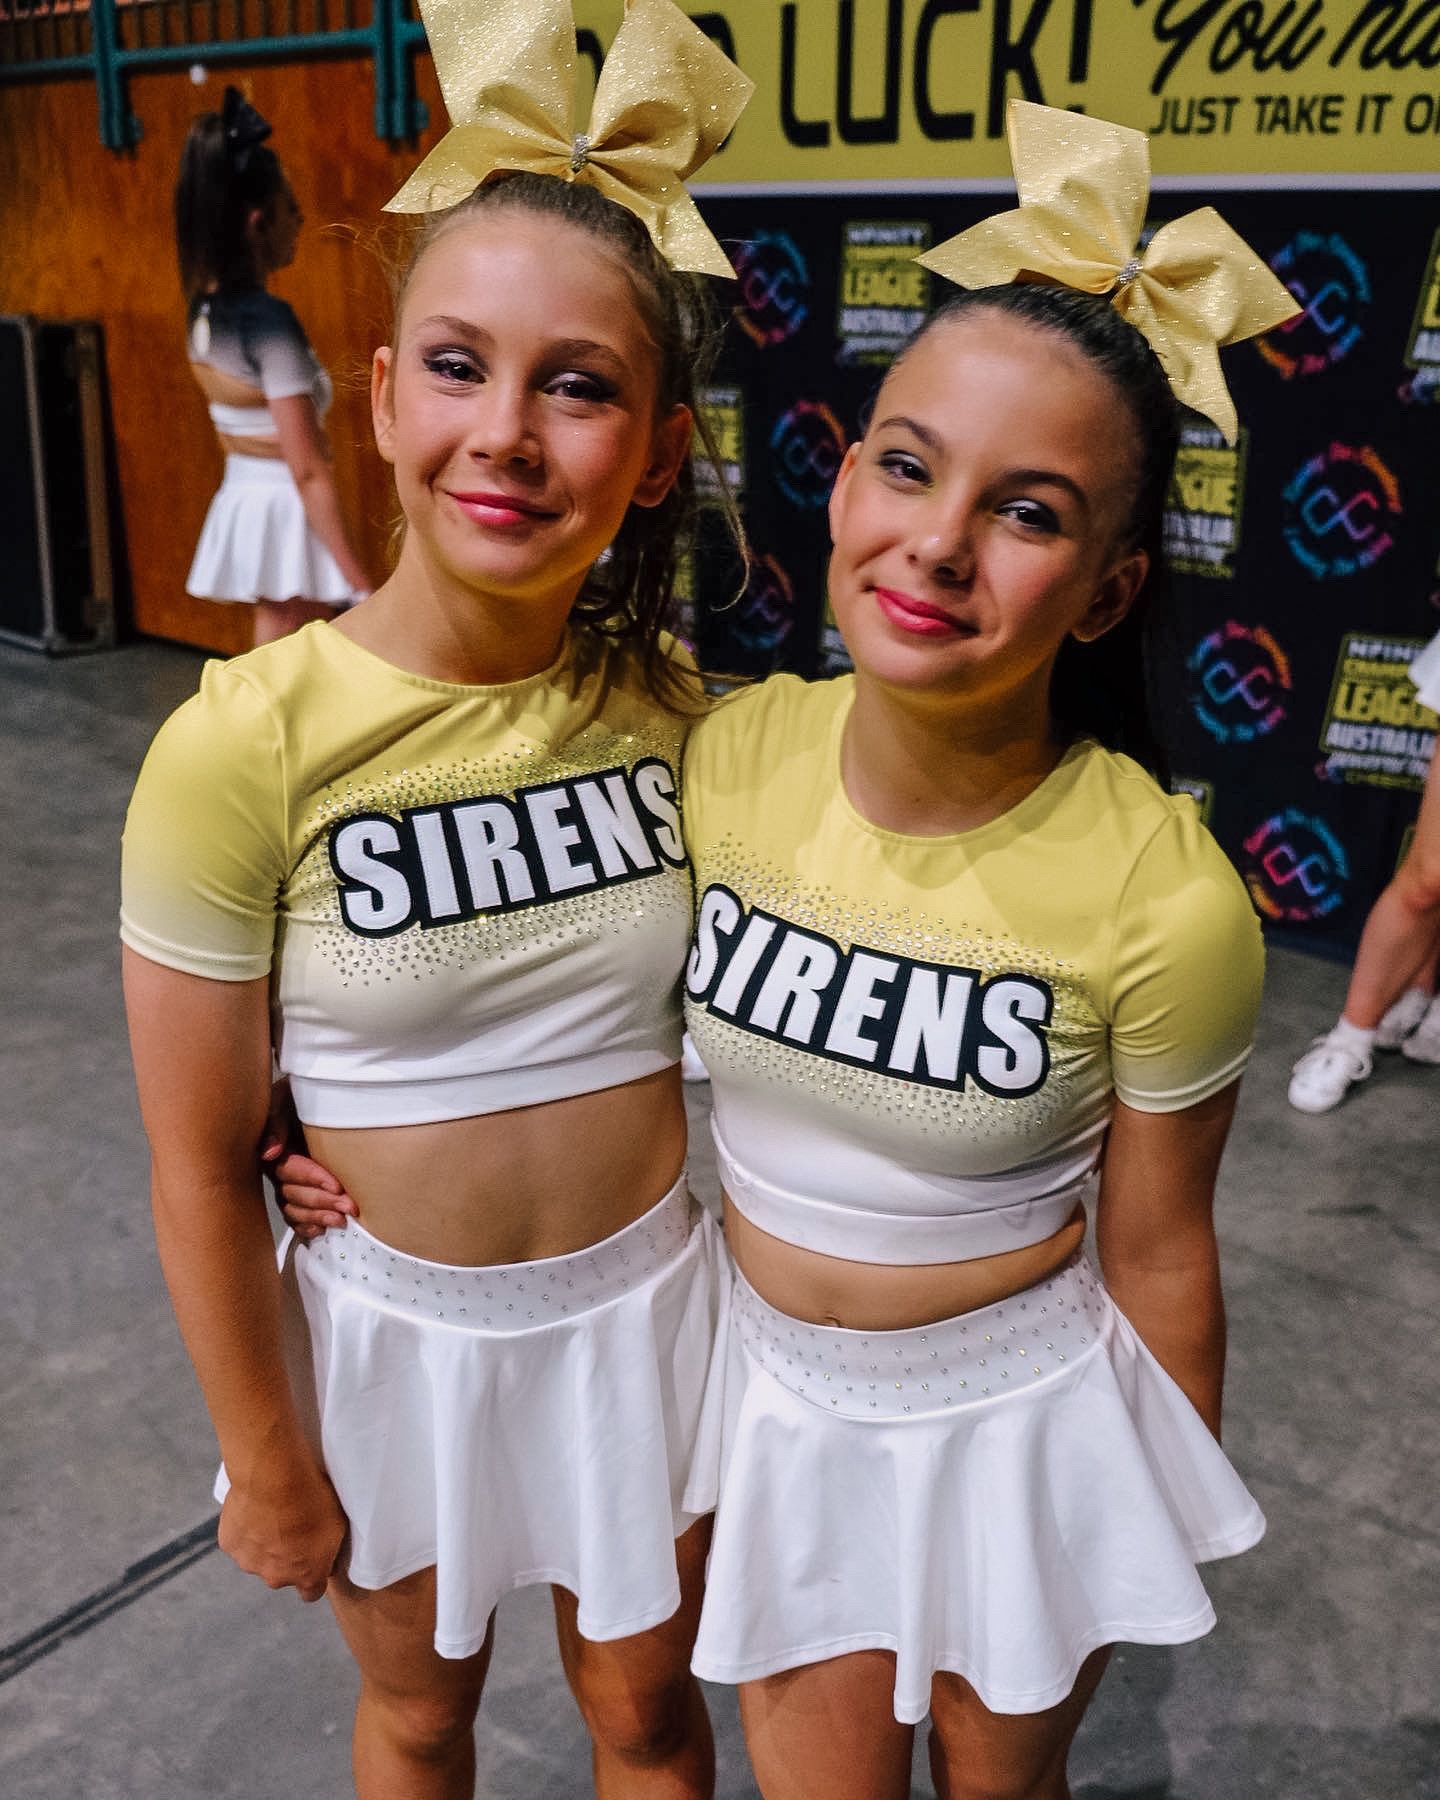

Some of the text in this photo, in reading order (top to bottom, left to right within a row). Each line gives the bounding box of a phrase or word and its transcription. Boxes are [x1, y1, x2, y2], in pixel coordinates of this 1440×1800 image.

[1150, 93, 1440, 134] JUST TAKE IT O
[843, 269, 925, 306] LEAGUE
[332, 758, 687, 934] SIRENS
[685, 885, 1054, 1095] SIRENS
